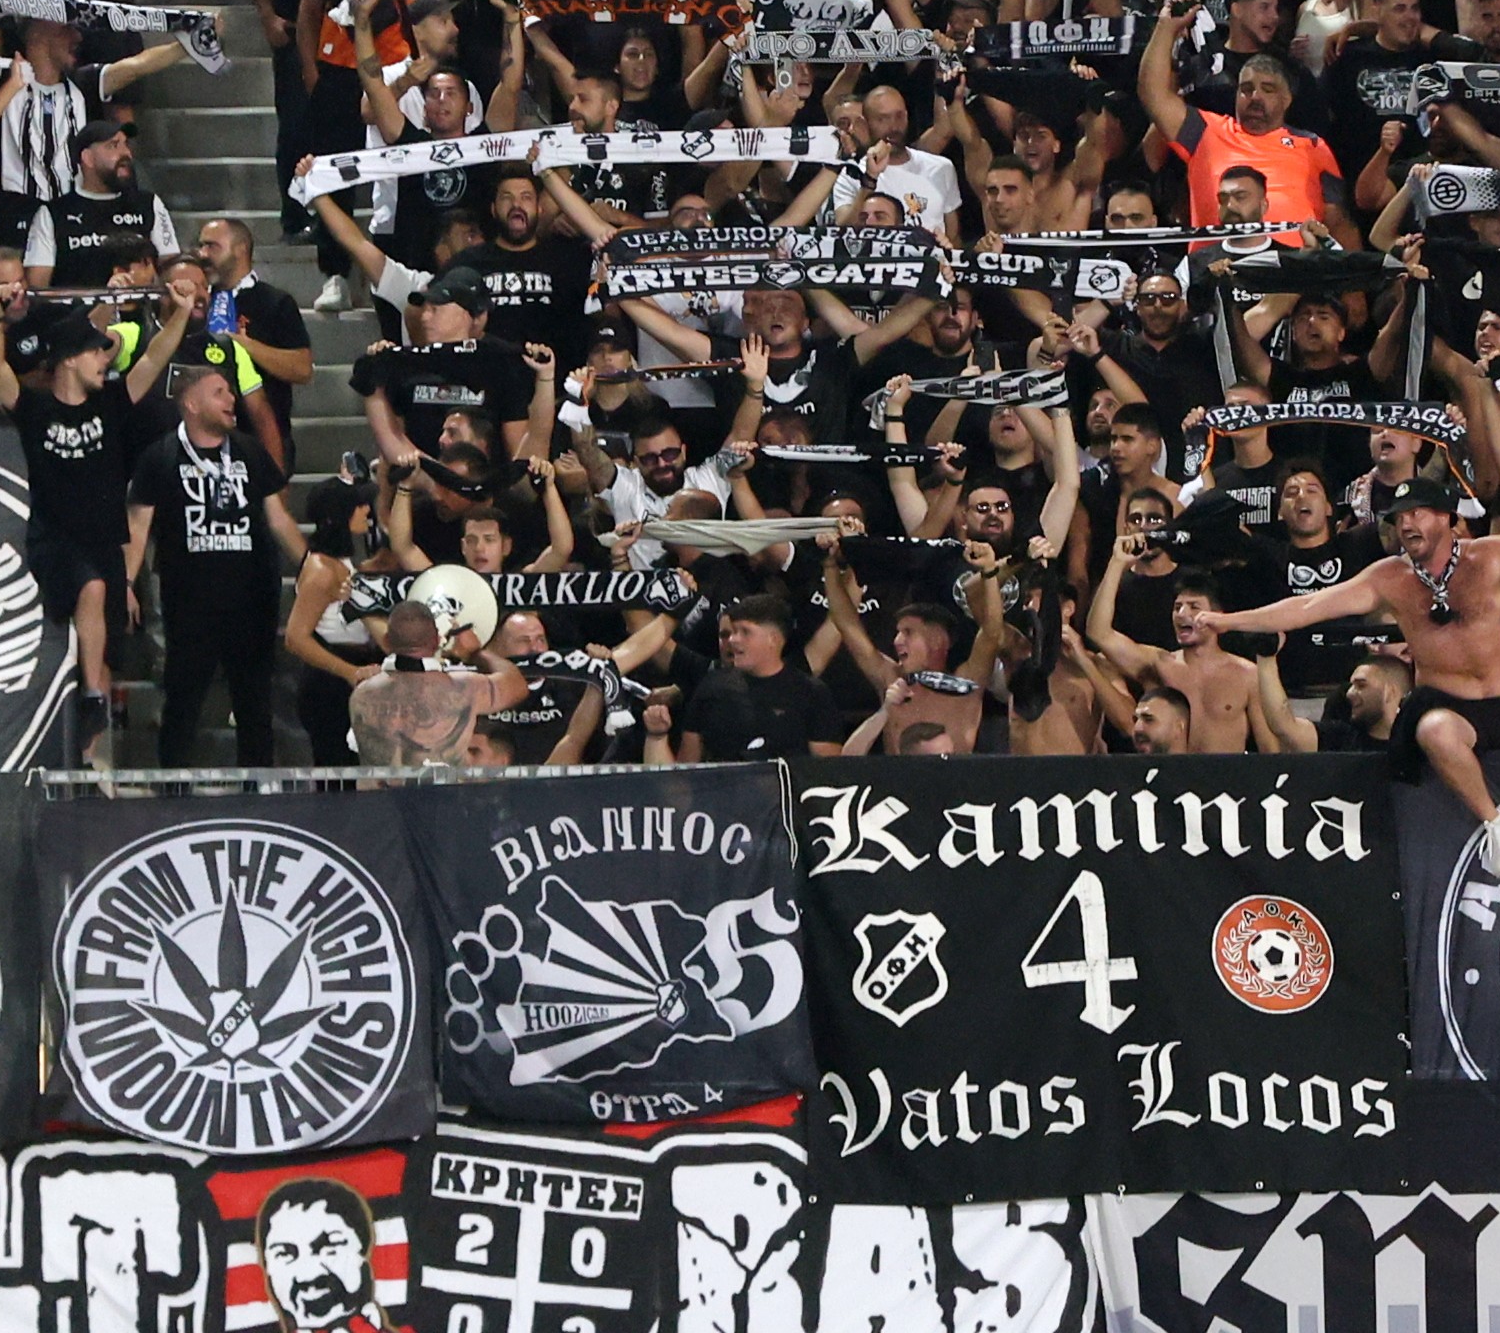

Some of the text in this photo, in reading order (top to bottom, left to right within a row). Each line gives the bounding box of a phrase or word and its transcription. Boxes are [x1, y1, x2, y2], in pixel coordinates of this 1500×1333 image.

[620, 228, 689, 250] UEFA
[979, 252, 1045, 274] CUP
[608, 261, 921, 290] KRITES GATE
[1020, 869, 1141, 1037] 4
[73, 839, 396, 1148] FROM THE HIGH MOUNTAINS
[821, 1039, 1401, 1160] Vatos Locos
[453, 1220, 608, 1281] 2 0
